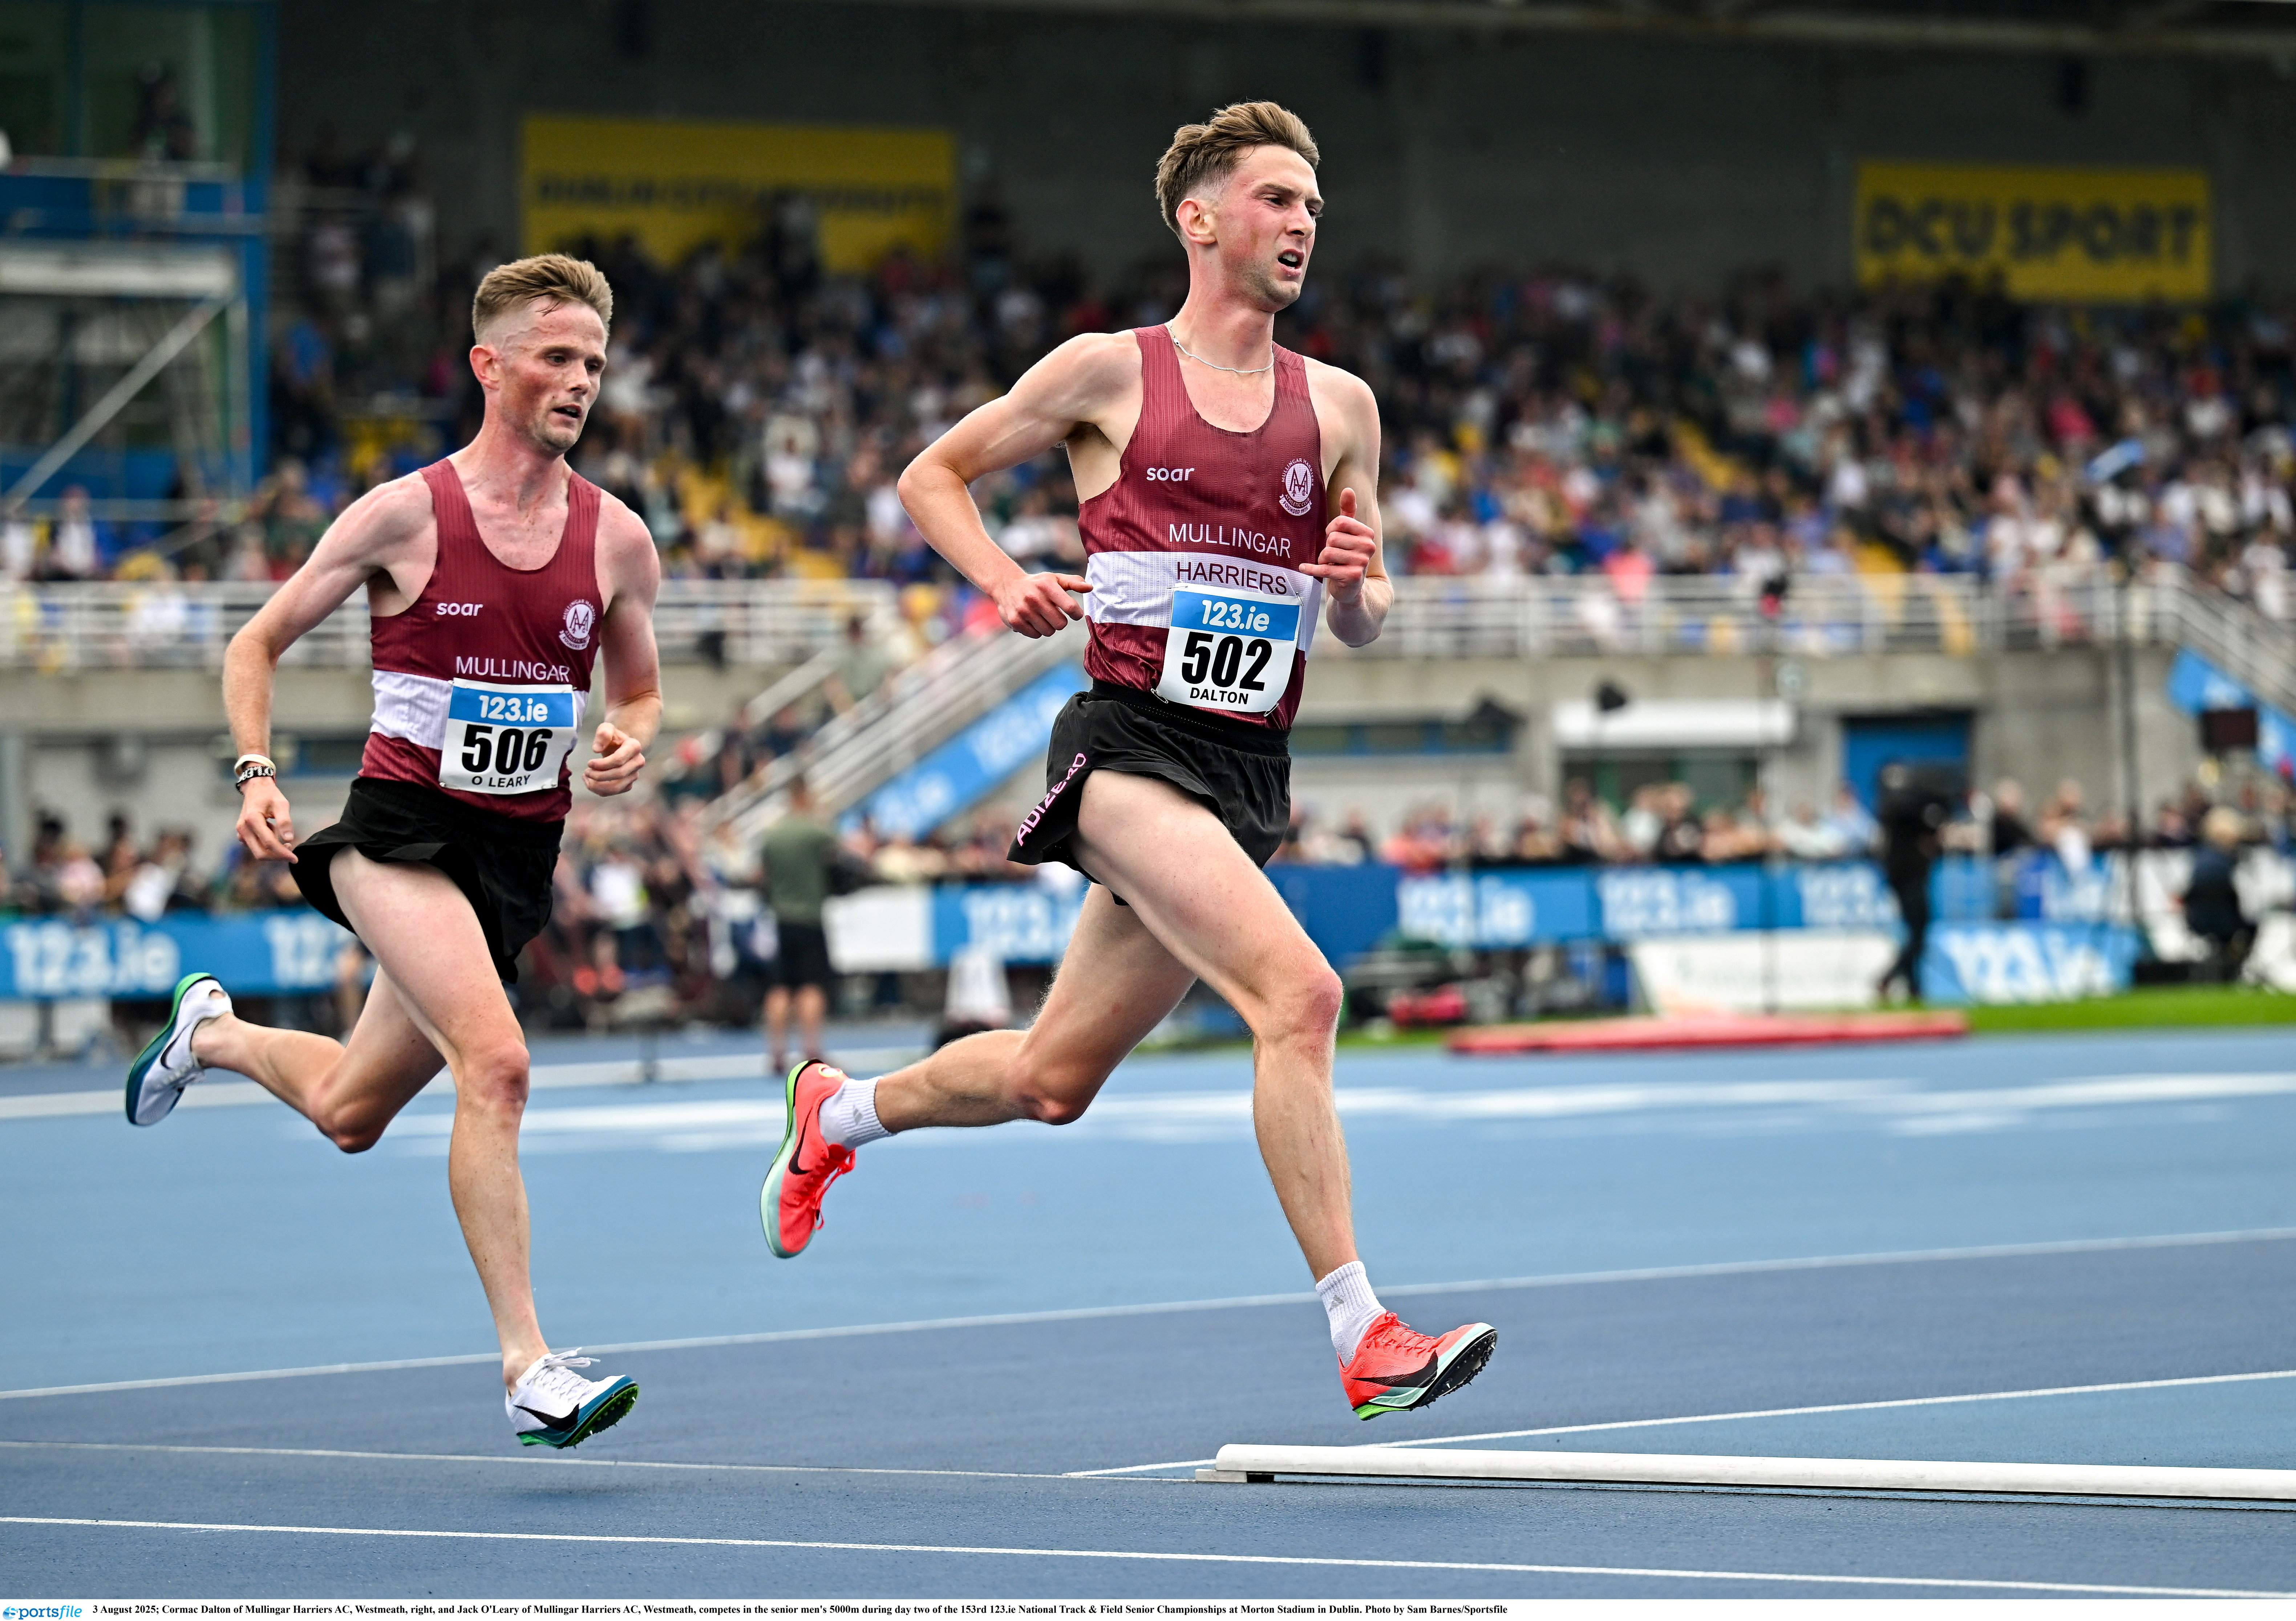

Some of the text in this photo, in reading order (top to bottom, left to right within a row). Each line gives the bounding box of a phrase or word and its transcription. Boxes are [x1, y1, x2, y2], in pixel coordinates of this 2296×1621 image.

[1146, 467, 1195, 482] soar
[1281, 458, 1303, 482] MULLINGAR
[1283, 501, 1300, 514] FOUNDED
[1285, 494, 1301, 507] ATHLETIC
[1169, 523, 1290, 559] MULLINGAR
[1177, 562, 1287, 595] HARRIERS
[436, 602, 483, 616] soar
[1202, 600, 1270, 632] 123.ie
[456, 656, 570, 682] MULLINGAR
[1182, 631, 1272, 691] 502
[479, 694, 548, 722] 123.ie
[1190, 687, 1248, 705] DALTON
[462, 724, 552, 775] 506
[472, 775, 531, 788] O LEARY
[10, 919, 180, 994] 123.ie
